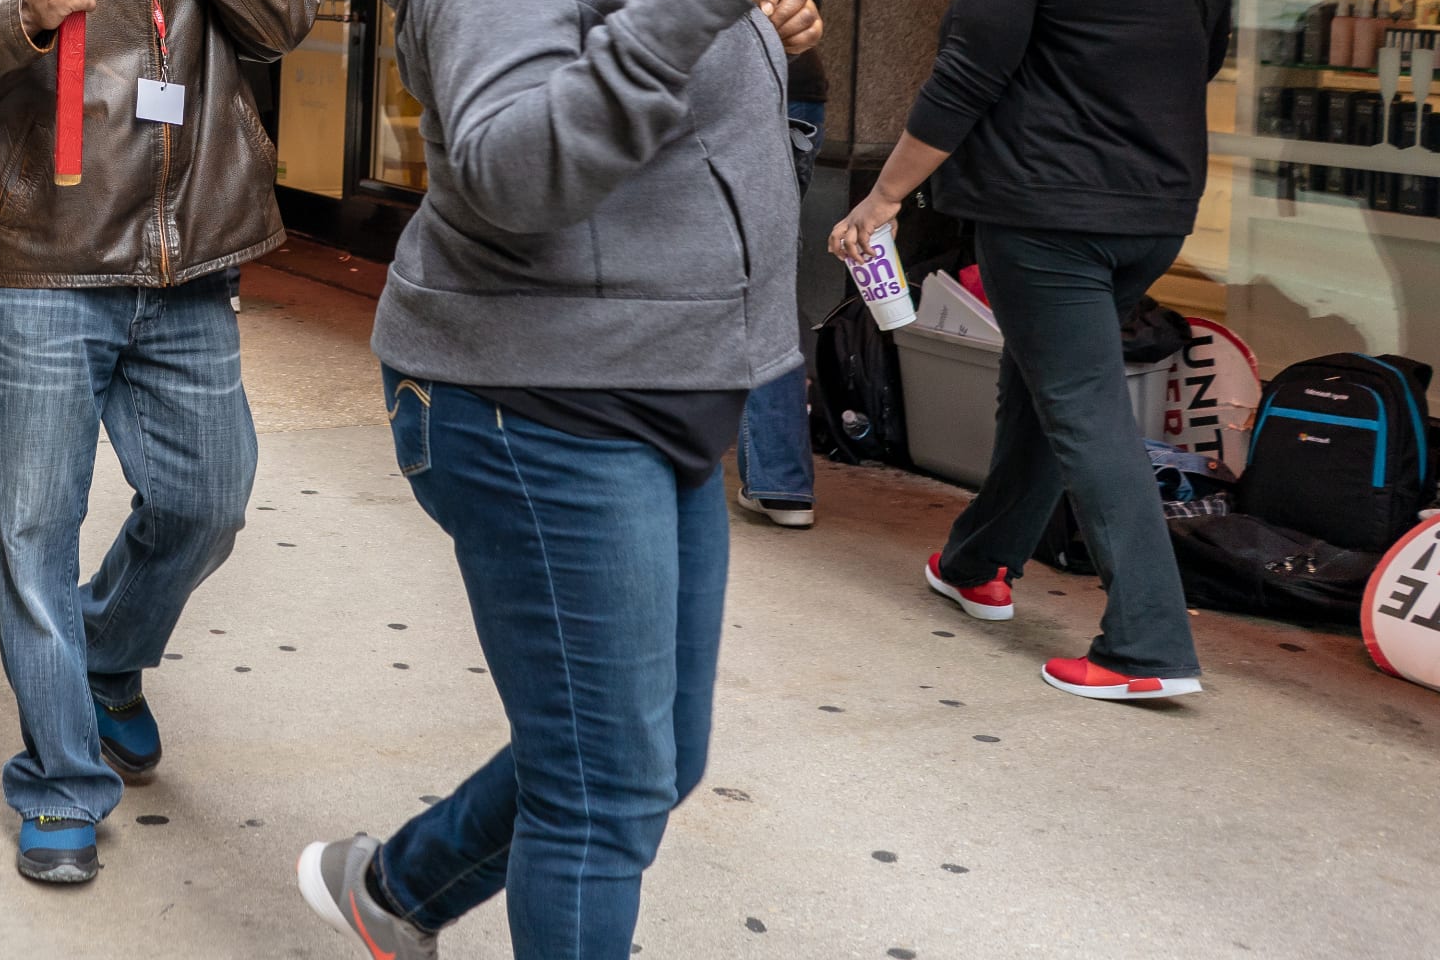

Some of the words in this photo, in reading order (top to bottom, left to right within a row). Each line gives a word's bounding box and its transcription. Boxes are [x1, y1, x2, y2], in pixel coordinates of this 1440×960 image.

[852, 258, 895, 287] on
[862, 281, 901, 302] ald's
[1182, 335, 1224, 462] UNIT
